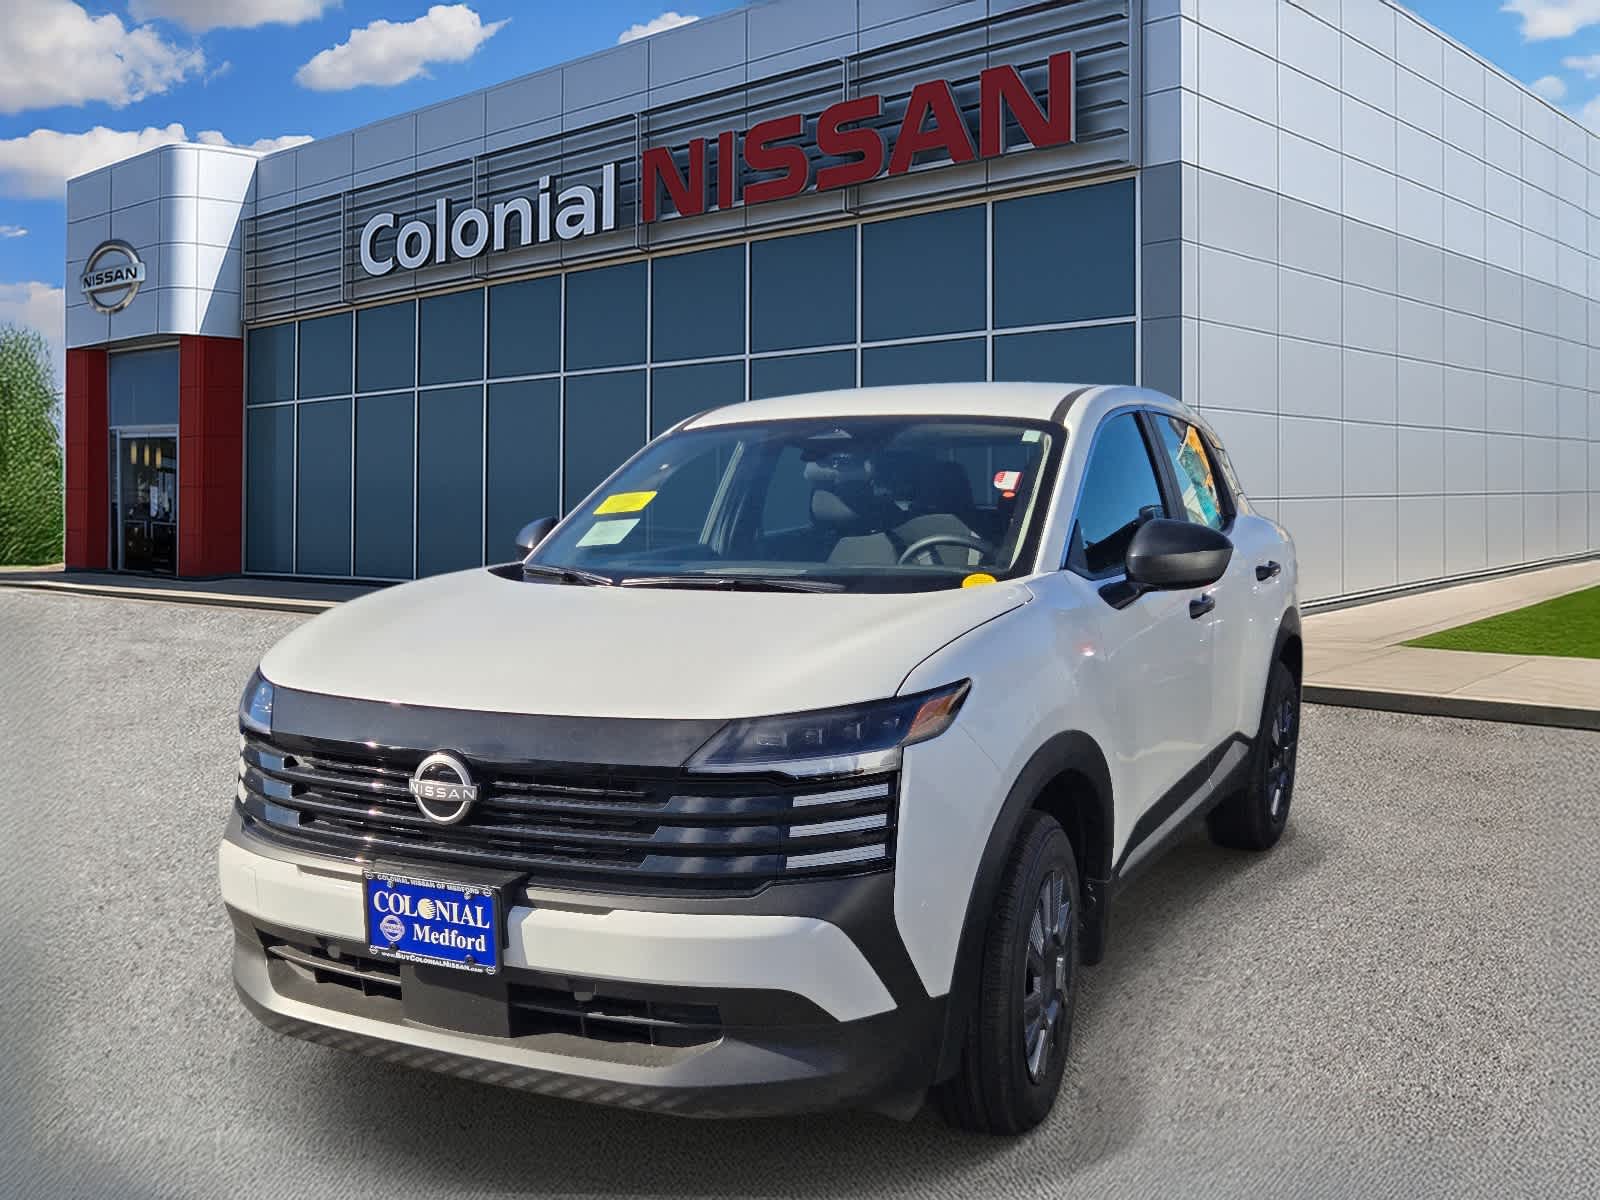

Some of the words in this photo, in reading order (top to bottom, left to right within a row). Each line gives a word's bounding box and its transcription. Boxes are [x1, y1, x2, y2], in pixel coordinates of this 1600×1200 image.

[360, 162, 617, 277] Colonial
[641, 50, 1077, 224] NISSAN
[82, 266, 138, 289] NISSAN
[410, 781, 476, 800] NISSAN
[373, 890, 490, 929] COLONIAL
[412, 923, 487, 952] Medford
